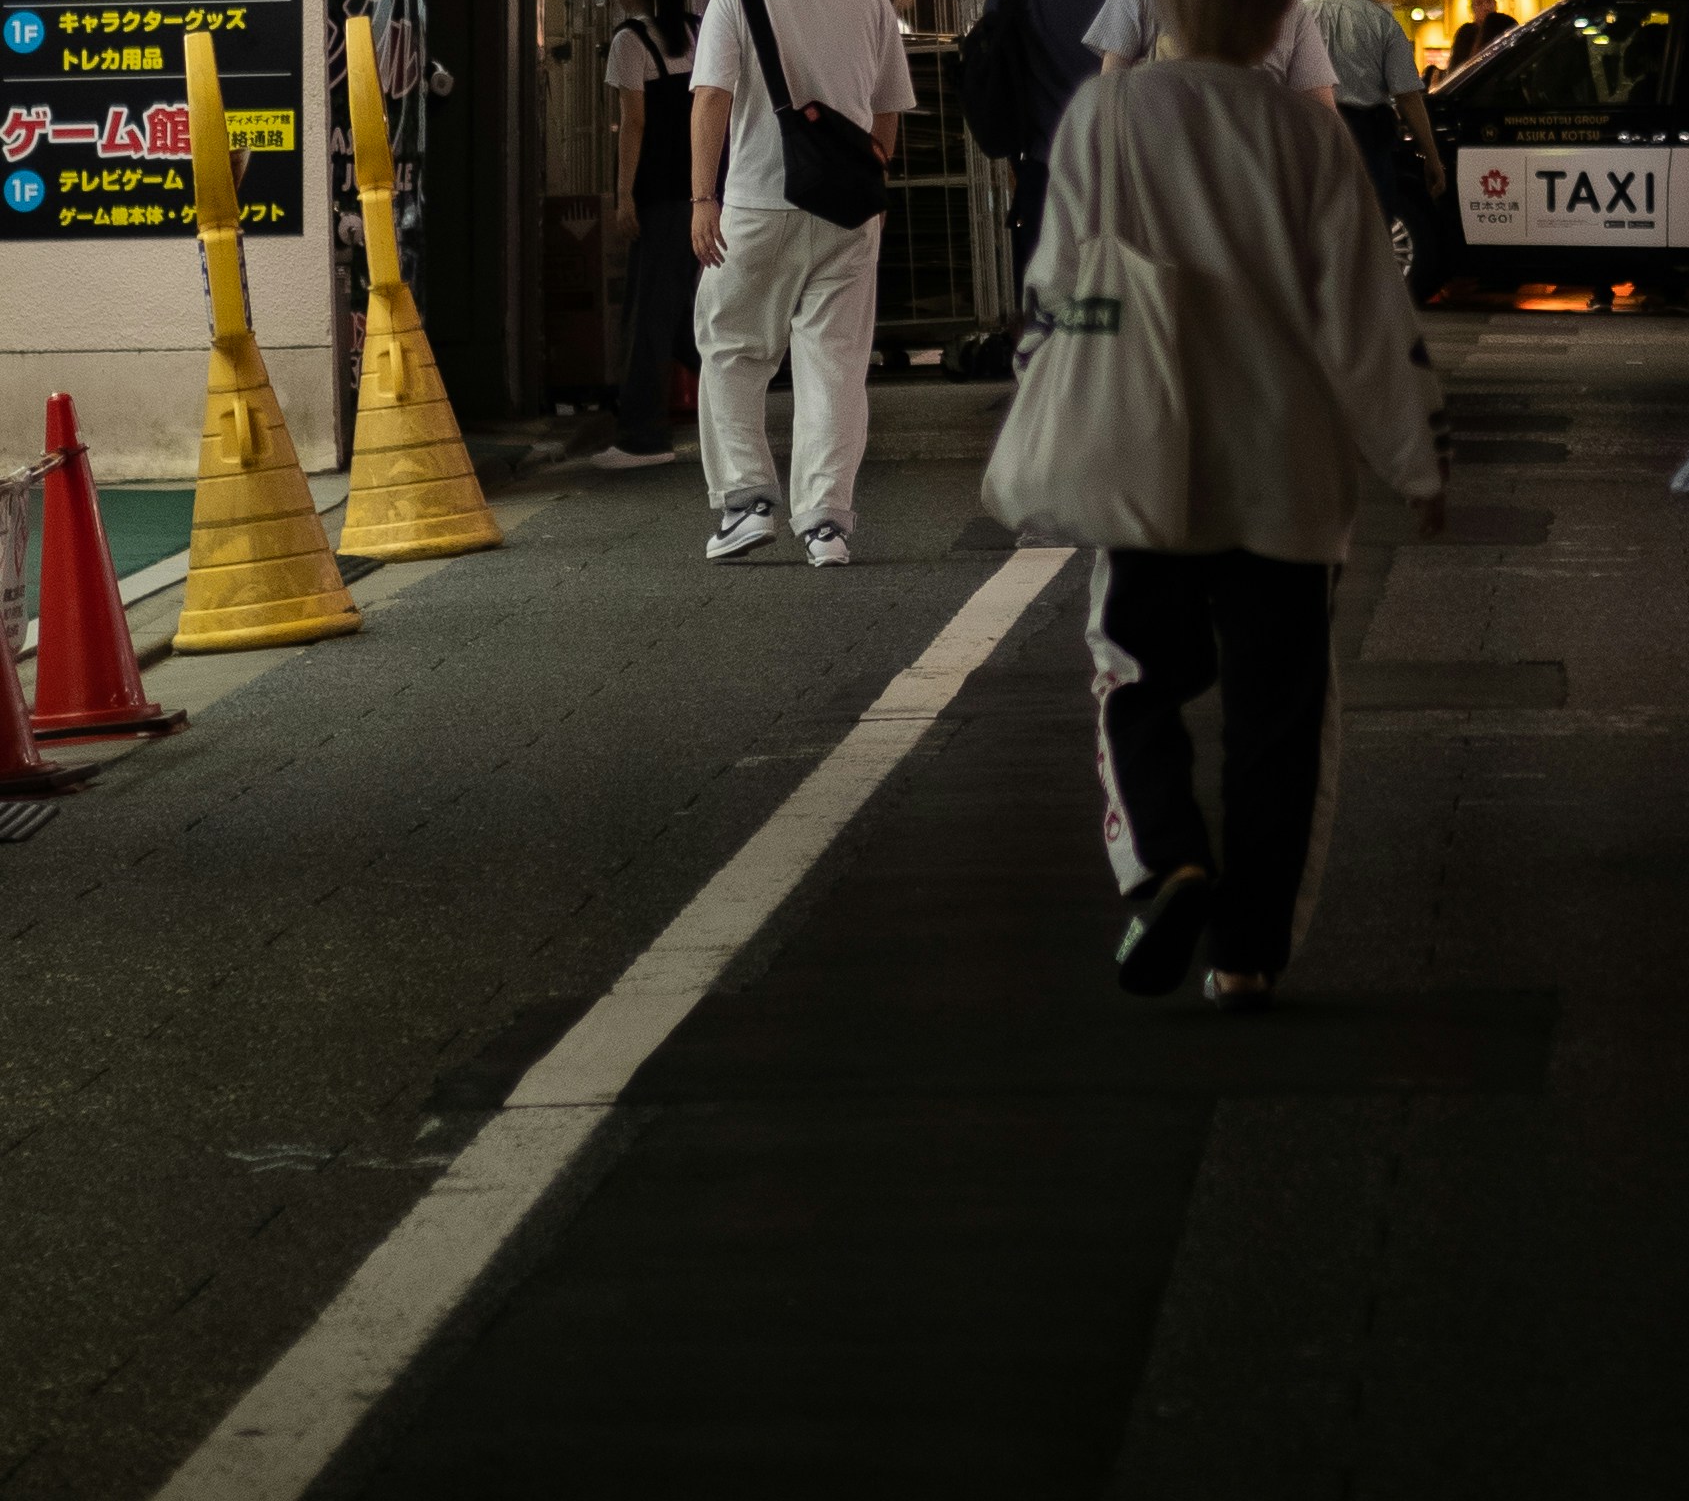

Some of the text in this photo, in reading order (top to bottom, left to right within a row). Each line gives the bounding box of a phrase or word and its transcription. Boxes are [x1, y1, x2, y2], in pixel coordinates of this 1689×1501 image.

[11, 19, 38, 44] 1F
[58, 7, 248, 33] キャラクターグッズ
[63, 45, 164, 71] トレカ用品
[1, 102, 193, 162] ゲーム館
[1504, 114, 1611, 126] NIHON KOTSU GROUP
[230, 130, 284, 148] 絡通路
[1516, 130, 1556, 142] ASUKA
[1560, 130, 1600, 142] KOTSU
[12, 178, 39, 203] 1F
[59, 167, 185, 193] テレビゲーム
[1535, 170, 1655, 215] TAXI
[1469, 201, 1520, 212] 日本交通
